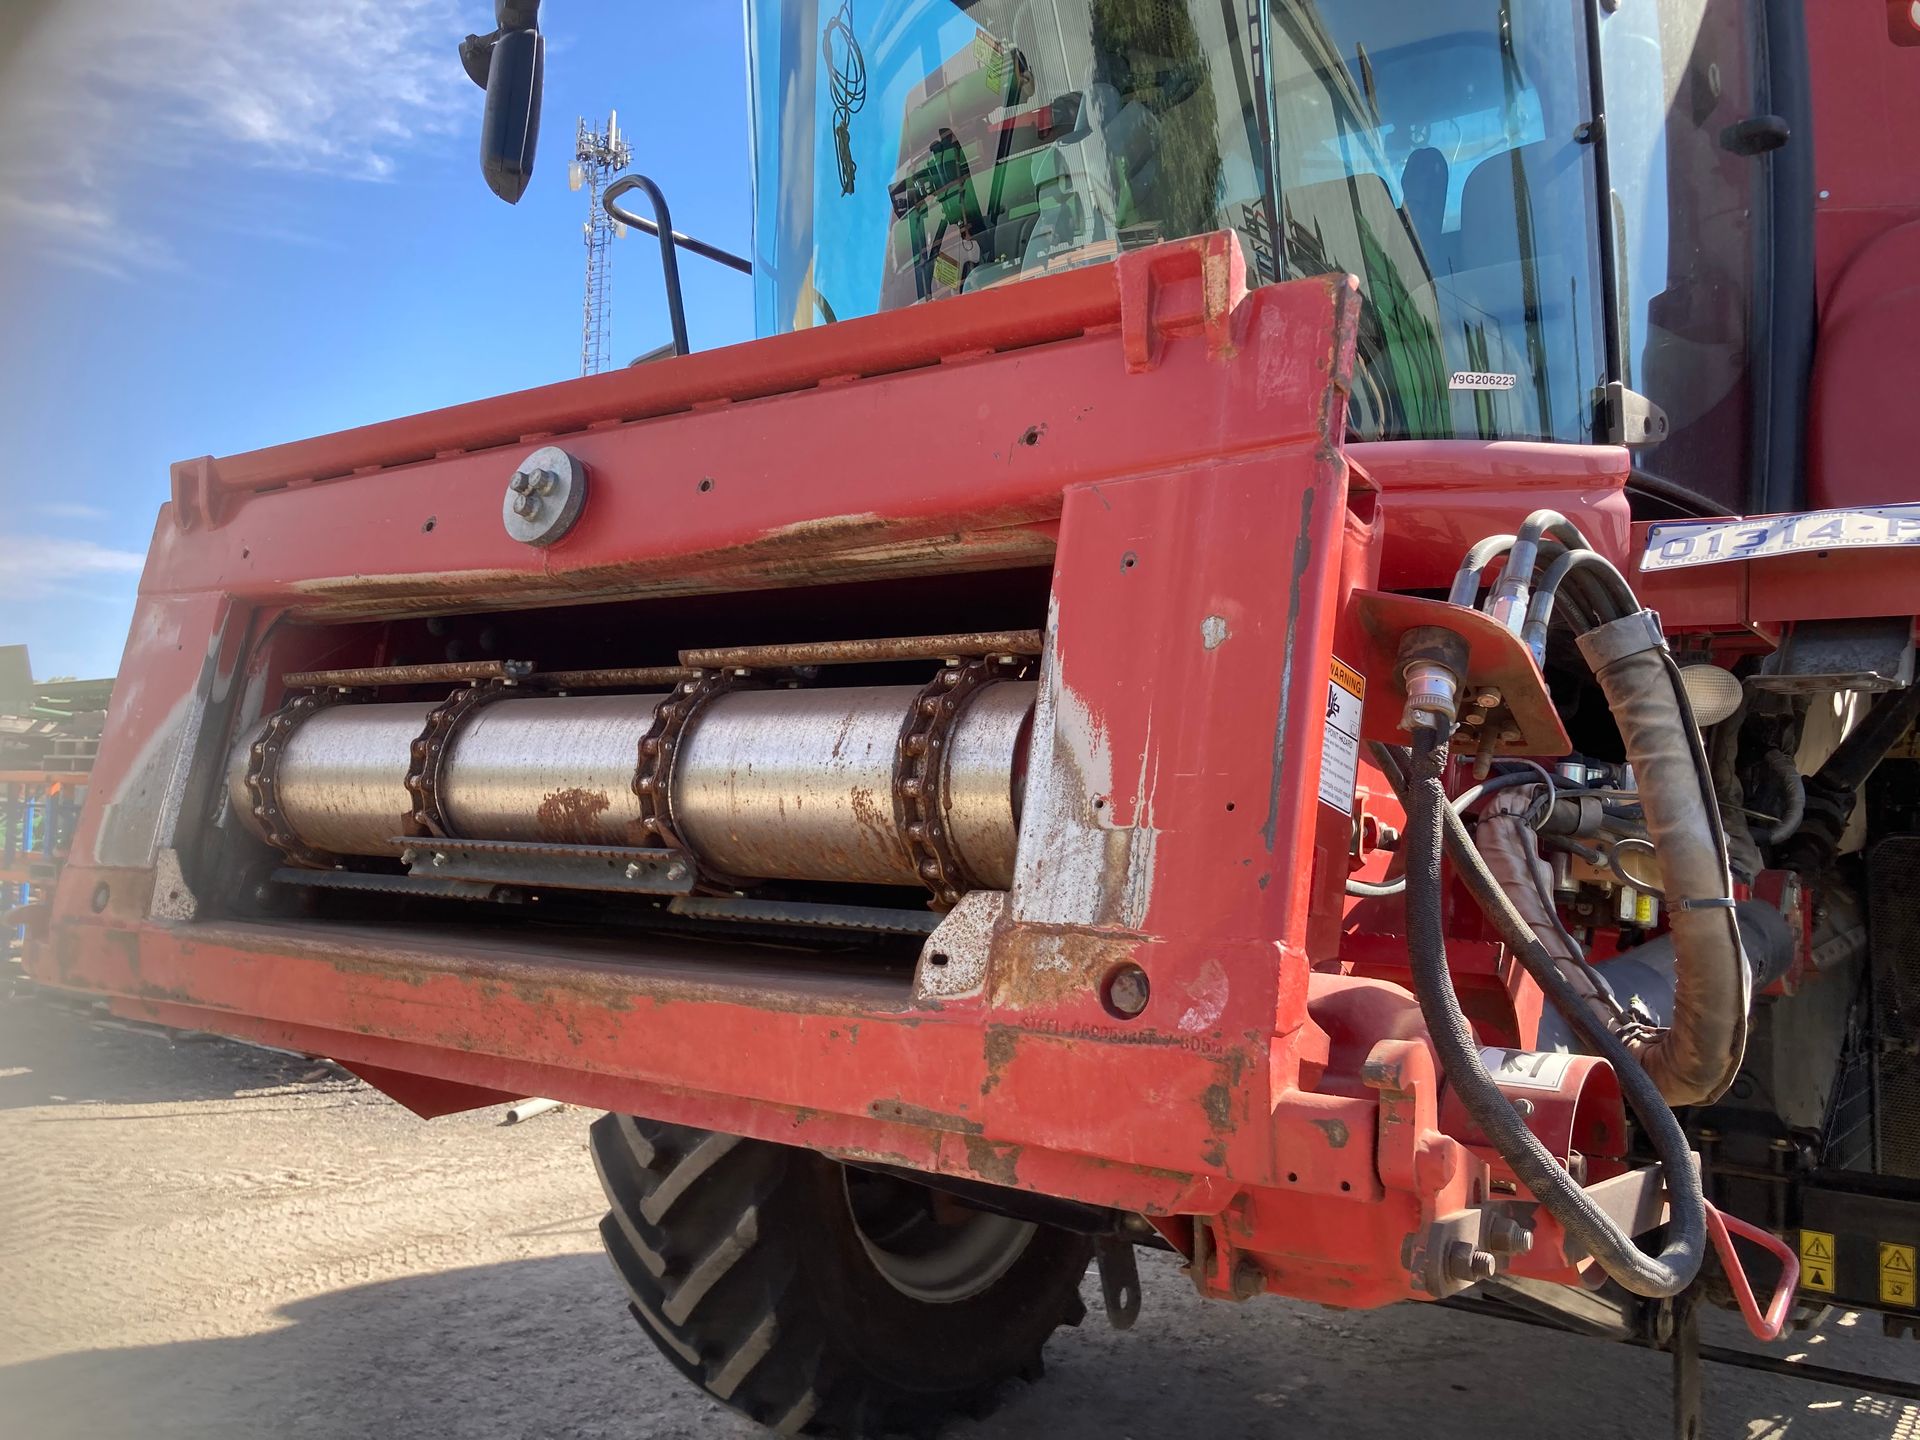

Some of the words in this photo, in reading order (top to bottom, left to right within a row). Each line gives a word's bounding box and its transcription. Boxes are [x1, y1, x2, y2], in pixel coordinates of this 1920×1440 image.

[1452, 374, 1515, 386] Y9G206223
[1656, 552, 1725, 566] VICTORIA
[1744, 545, 1772, 555] THE
[1780, 537, 1878, 549] EDUCATION
